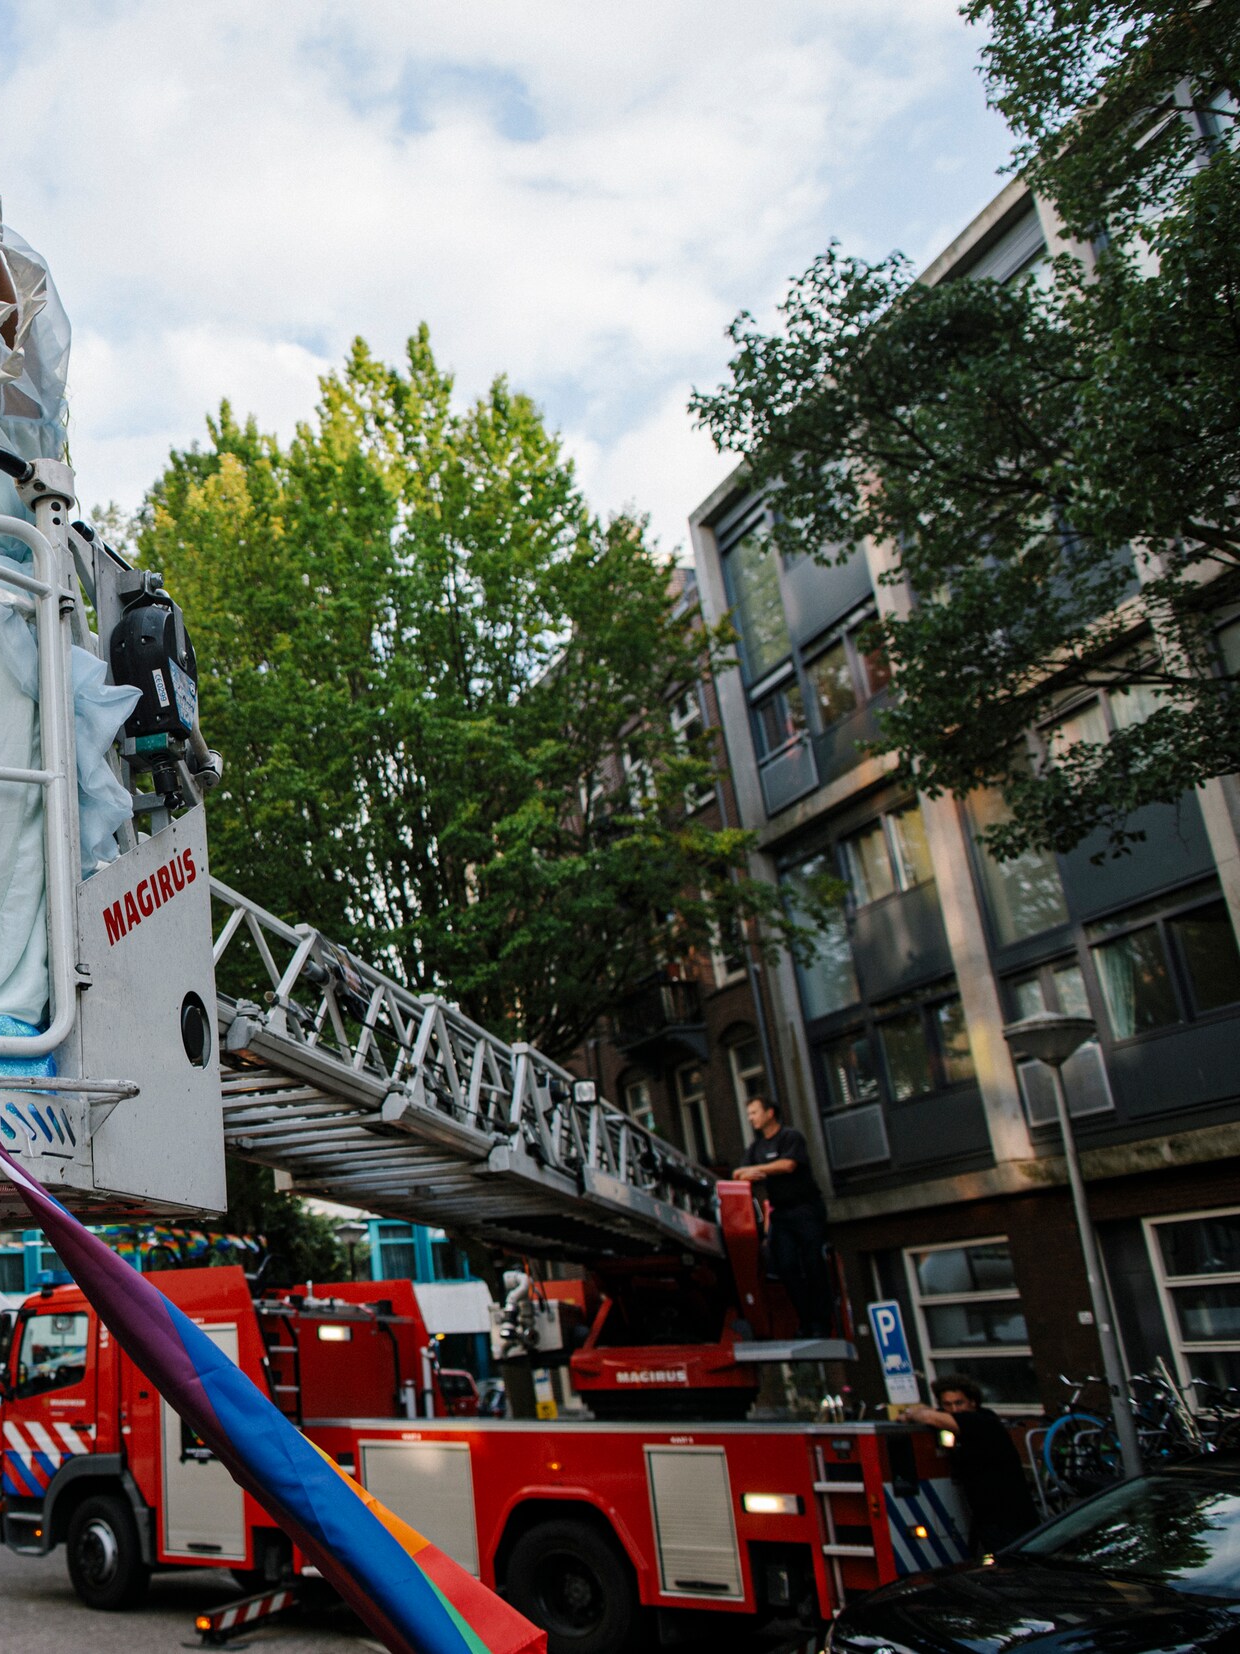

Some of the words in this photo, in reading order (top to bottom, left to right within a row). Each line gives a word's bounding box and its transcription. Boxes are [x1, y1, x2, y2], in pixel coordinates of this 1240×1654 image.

[102, 847, 197, 947] MAGIRUS
[876, 1308, 896, 1348] P
[615, 1369, 687, 1384] MAGIRUS
